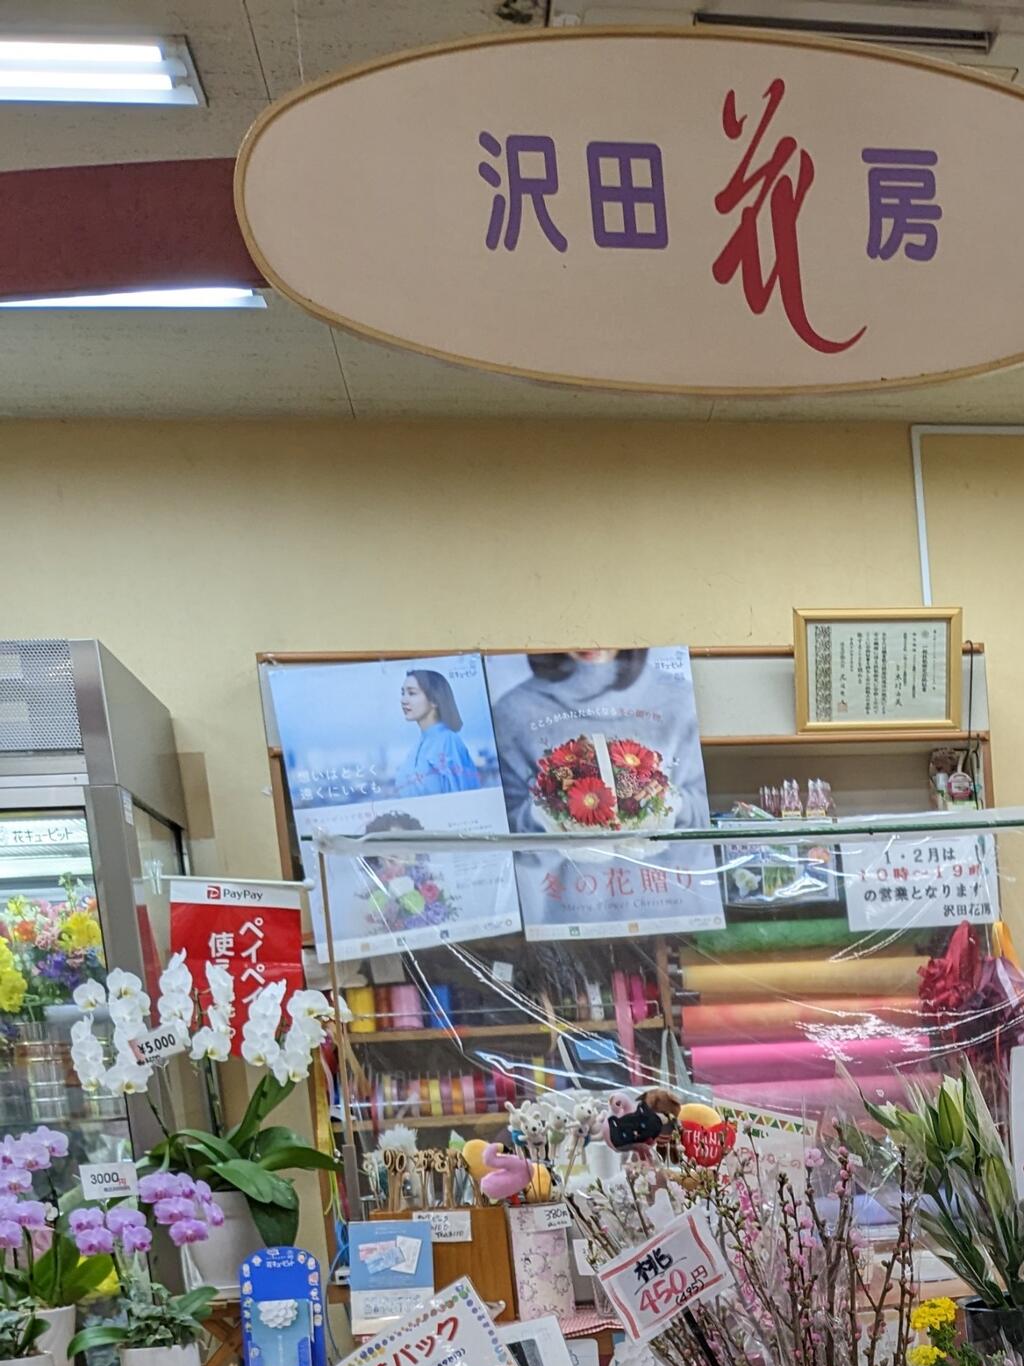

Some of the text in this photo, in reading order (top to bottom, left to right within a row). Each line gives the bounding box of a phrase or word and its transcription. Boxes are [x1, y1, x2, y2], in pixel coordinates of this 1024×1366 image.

[479, 78, 942, 354] 沢田花房
[223, 888, 263, 901] PayPay
[542, 865, 693, 900] 冬の花贈り
[634, 1247, 673, 1284] 桃
